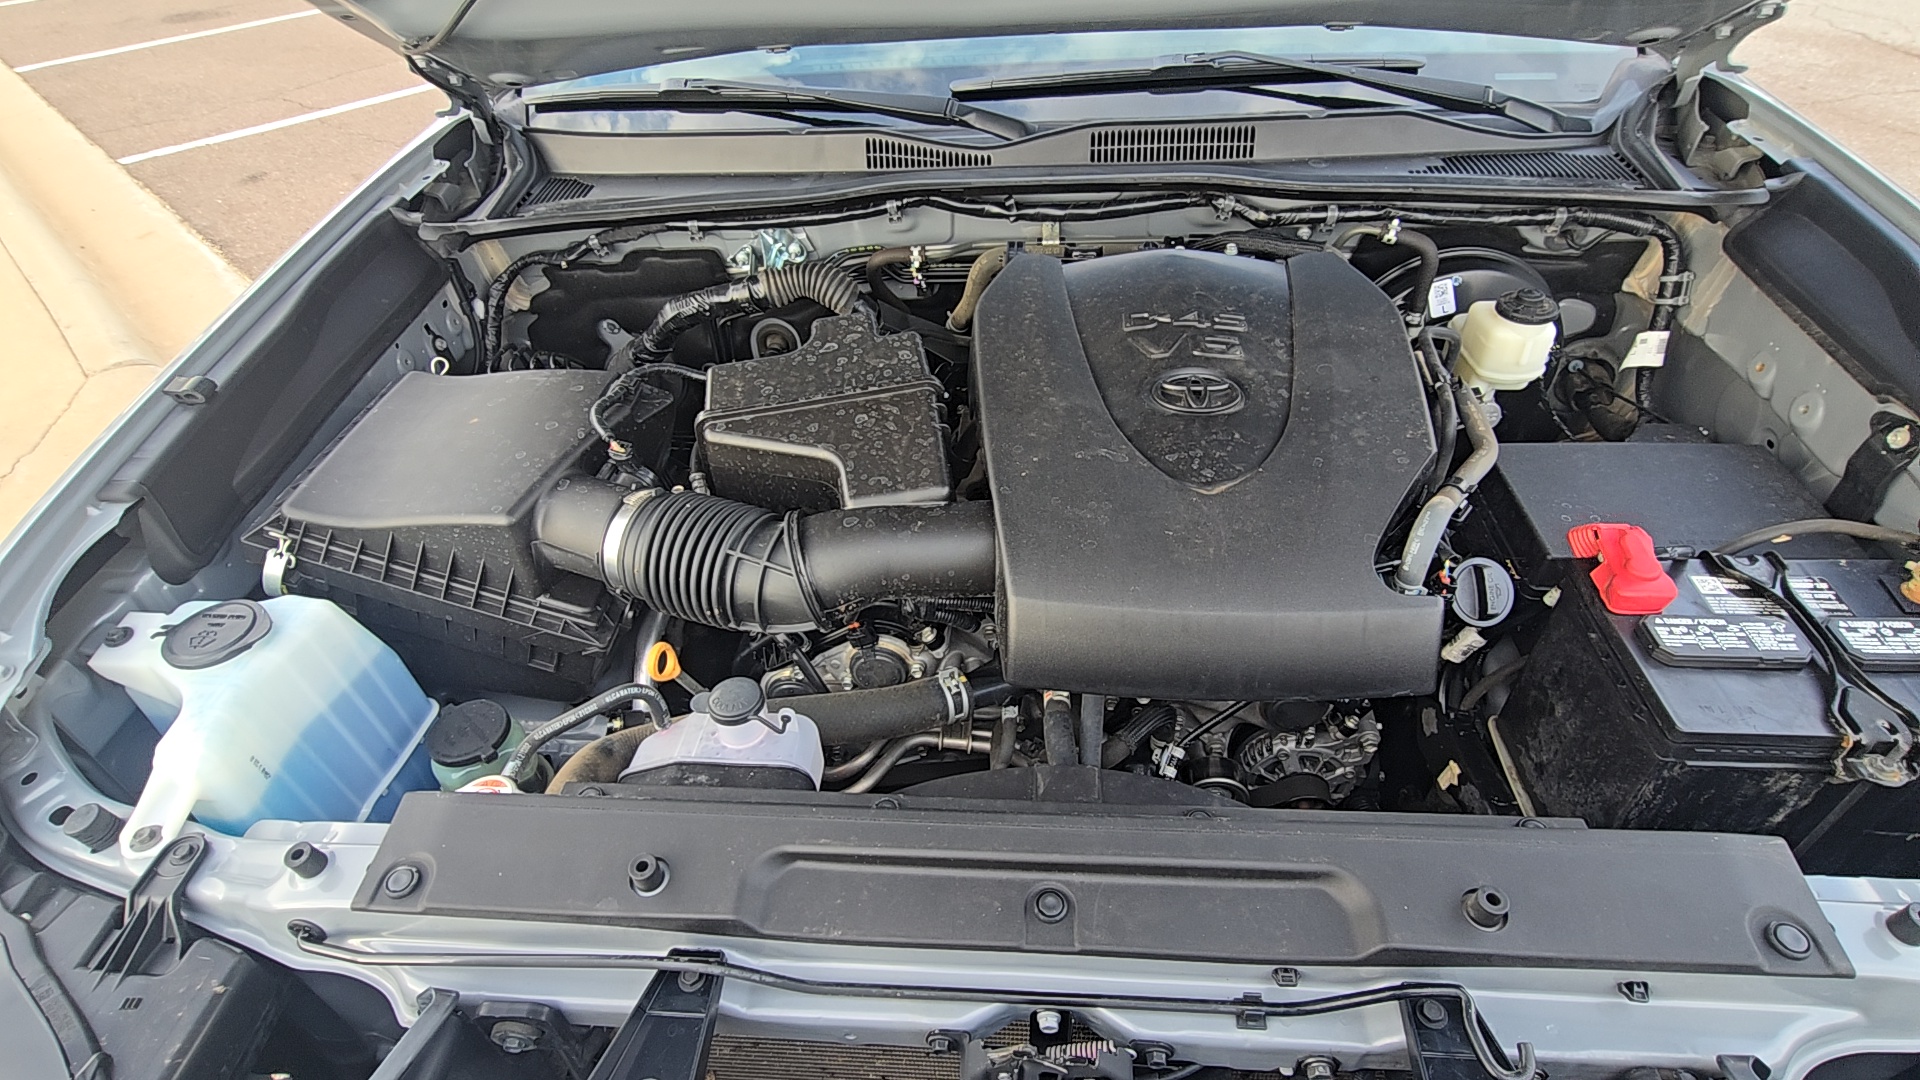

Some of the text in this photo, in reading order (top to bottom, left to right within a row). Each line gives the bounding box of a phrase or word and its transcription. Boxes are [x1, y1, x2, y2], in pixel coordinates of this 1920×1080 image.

[1126, 332, 1245, 360] V6
[1488, 585, 1497, 610] ENGINE
[712, 697, 749, 713] COOLANT
